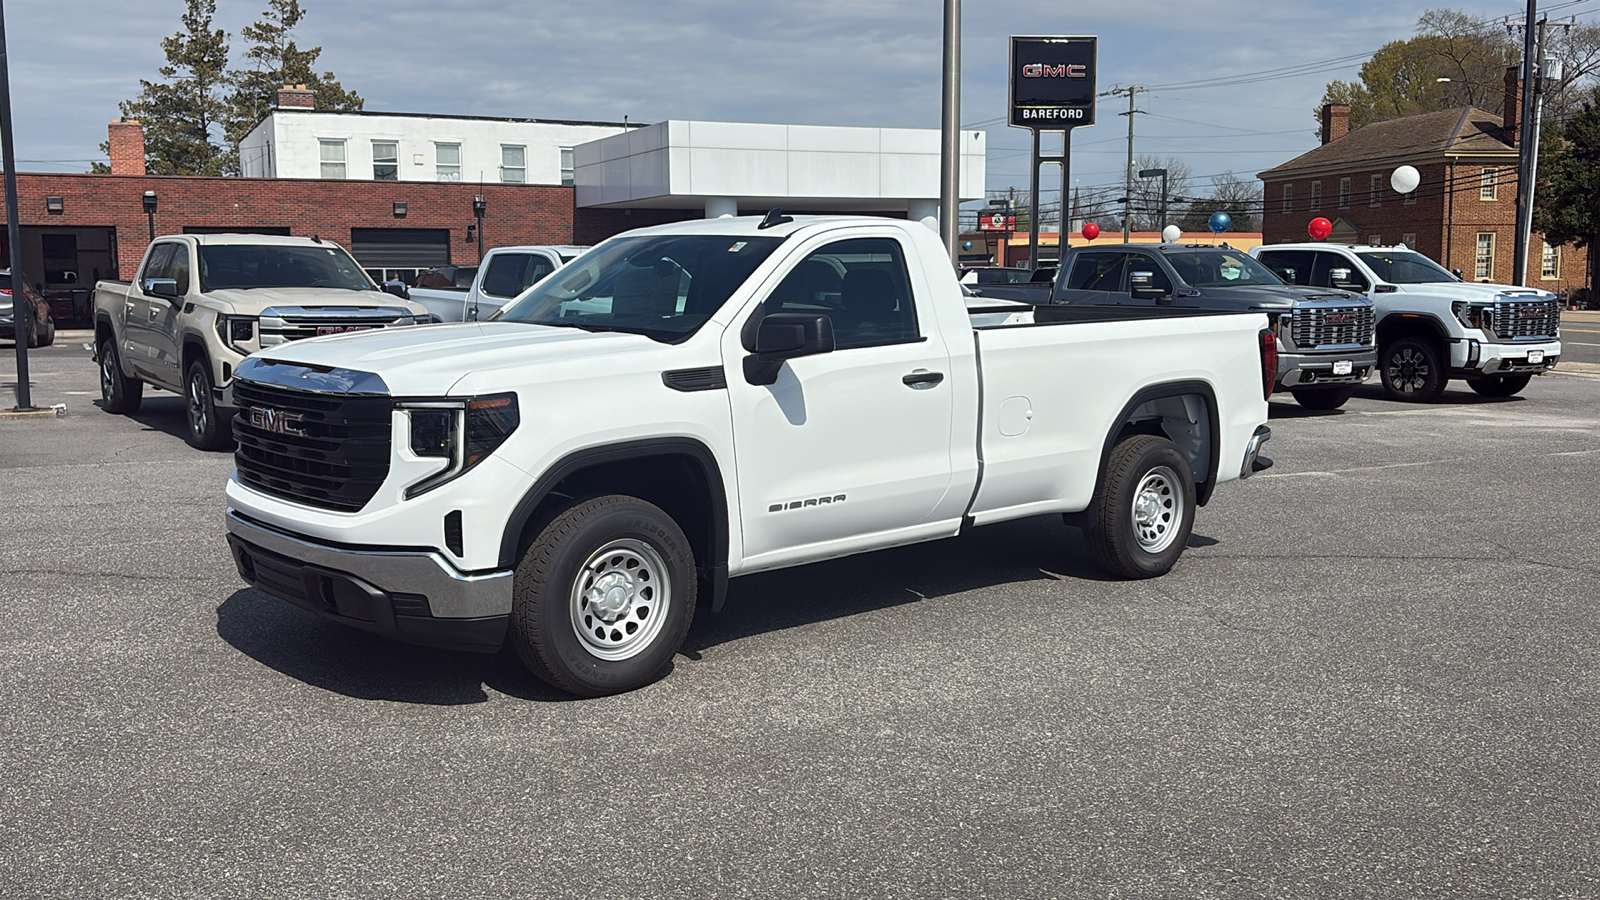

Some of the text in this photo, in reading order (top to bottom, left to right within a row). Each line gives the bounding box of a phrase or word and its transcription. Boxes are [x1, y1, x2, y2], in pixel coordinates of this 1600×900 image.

[1022, 63, 1086, 78] GMC
[1022, 109, 1084, 119] BAREFORD
[250, 405, 305, 438] GMC
[768, 494, 847, 513] SIERRA
